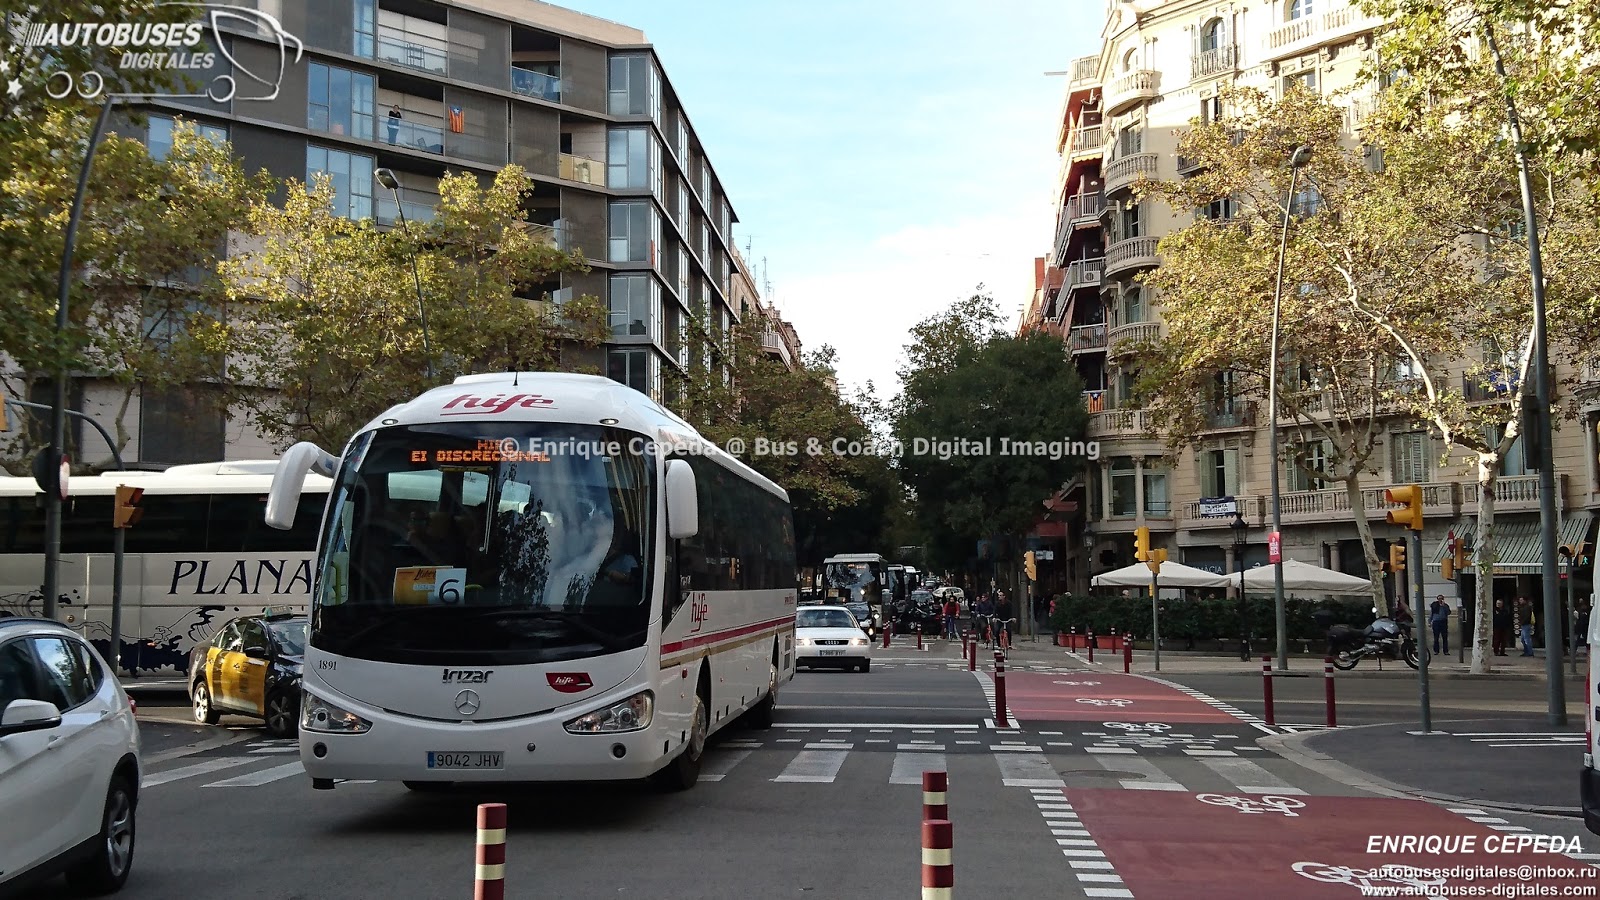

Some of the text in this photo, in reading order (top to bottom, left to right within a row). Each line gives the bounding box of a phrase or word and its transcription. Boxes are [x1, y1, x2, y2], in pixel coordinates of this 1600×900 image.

[440, 393, 559, 417] hife
[167, 559, 313, 595] PLANA
[438, 578, 460, 604] 6
[318, 659, 338, 671] 1891
[442, 668, 494, 684] Irizar
[436, 753, 501, 767] 9042 JHV
